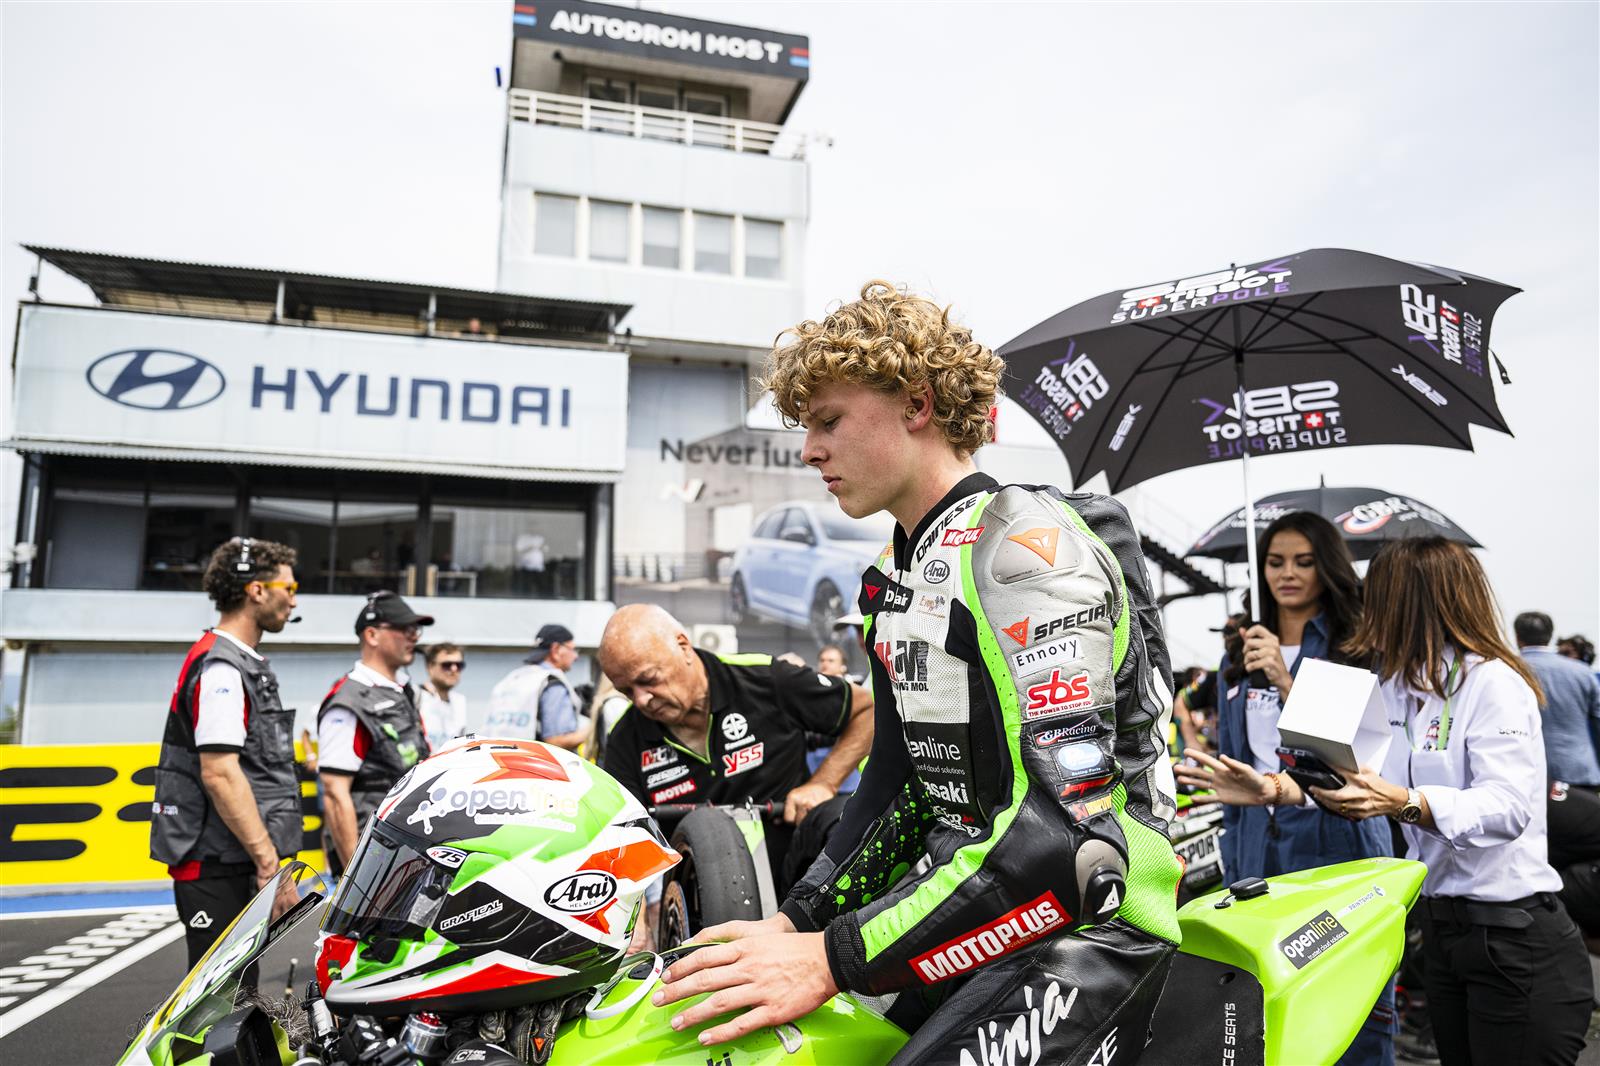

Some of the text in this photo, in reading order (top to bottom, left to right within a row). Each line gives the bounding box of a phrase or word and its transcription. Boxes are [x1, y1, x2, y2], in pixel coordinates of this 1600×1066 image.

[550, 10, 783, 63] AUTODROM MOST
[251, 366, 571, 427] HYUNDAI
[660, 439, 805, 470] Never jus
[916, 496, 978, 563] DAINESE
[1034, 604, 1109, 641] SPECIA
[1016, 639, 1077, 667] Ennovy
[1028, 670, 1090, 710] sbs
[909, 736, 961, 761] enline
[655, 780, 695, 803] MOTUL
[550, 876, 610, 904] Arai
[569, 900, 597, 908] HELMET
[918, 900, 1060, 982] MOTOPLUS
[1283, 916, 1338, 958] openline
[960, 981, 1079, 1066] Ninja
[1224, 1002, 1236, 1046] SEATS
[1222, 1048, 1236, 1066] CE
